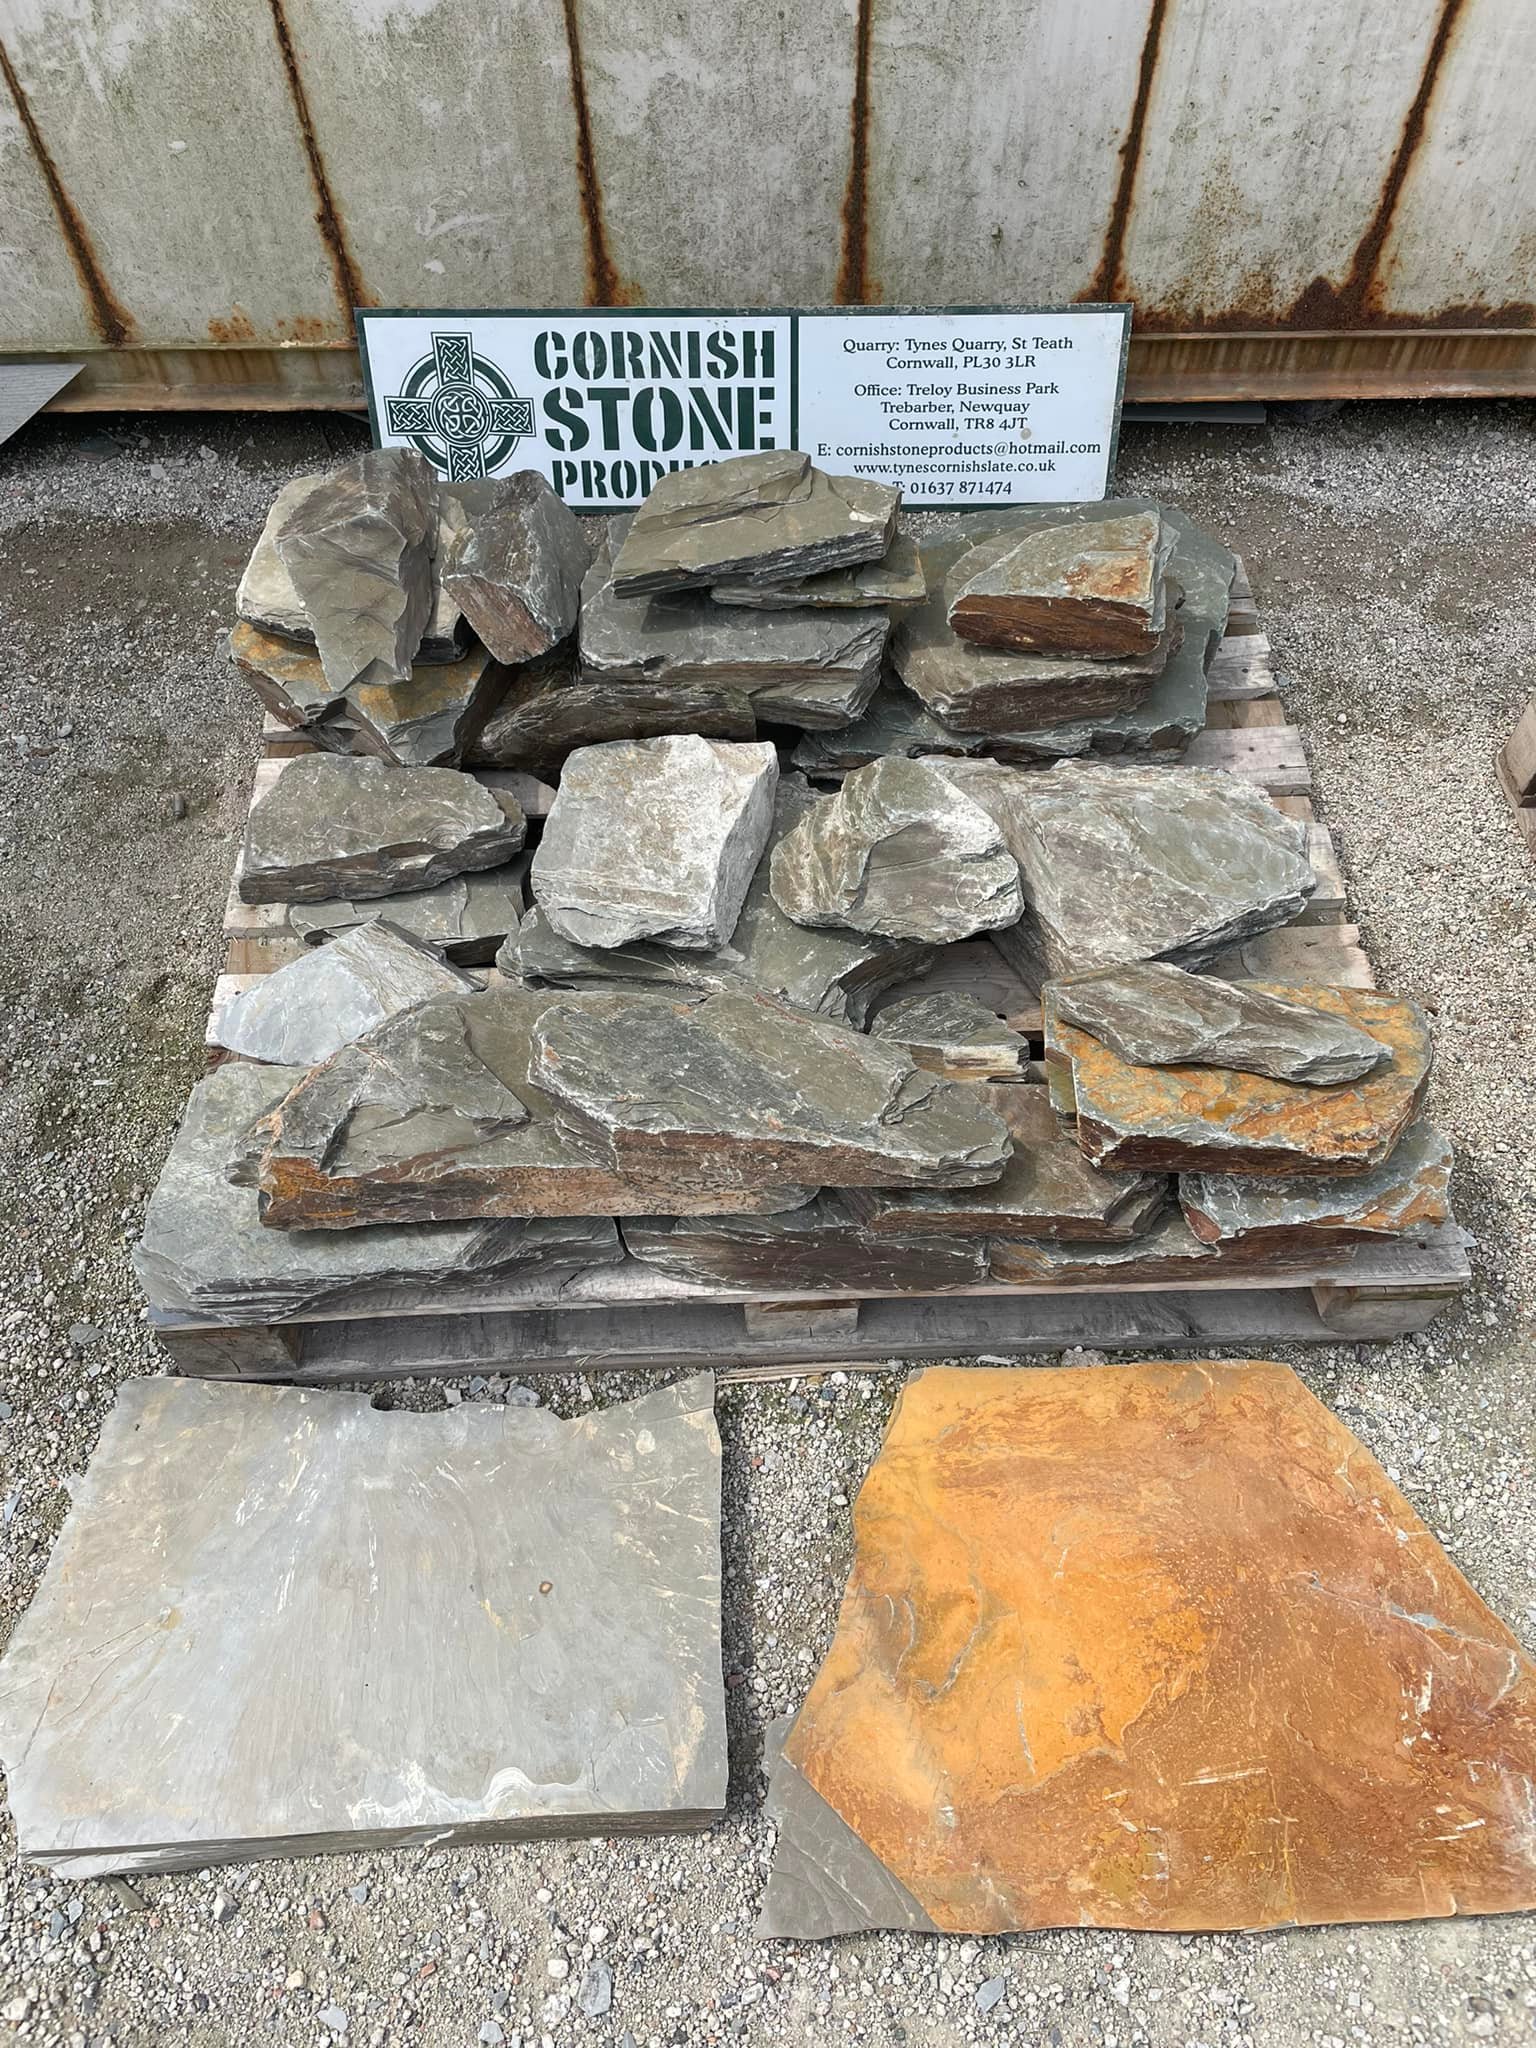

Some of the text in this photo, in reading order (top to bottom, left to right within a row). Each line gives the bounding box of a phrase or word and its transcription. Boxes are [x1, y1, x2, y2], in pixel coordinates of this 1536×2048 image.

[843, 336, 1074, 353] Quarry: Tynes Quarry, St Teath
[533, 330, 775, 380] CORNISH
[886, 355, 1036, 370] Cornwall, PL30 3LR
[854, 382, 1060, 398] Office: Treloy Business Park
[880, 400, 1031, 415] Trebarber, Newquay
[542, 386, 776, 452] STONE
[888, 417, 1028, 432] Cornwall, TR8 4JT
[817, 440, 1101, 459] E: cornishstoneproducts@hotmail.com
[853, 459, 1056, 475] www.tynescornishslate.co.uk
[552, 460, 721, 499] PROD
[910, 481, 954, 495] 01637
[958, 480, 1012, 495] 871474
